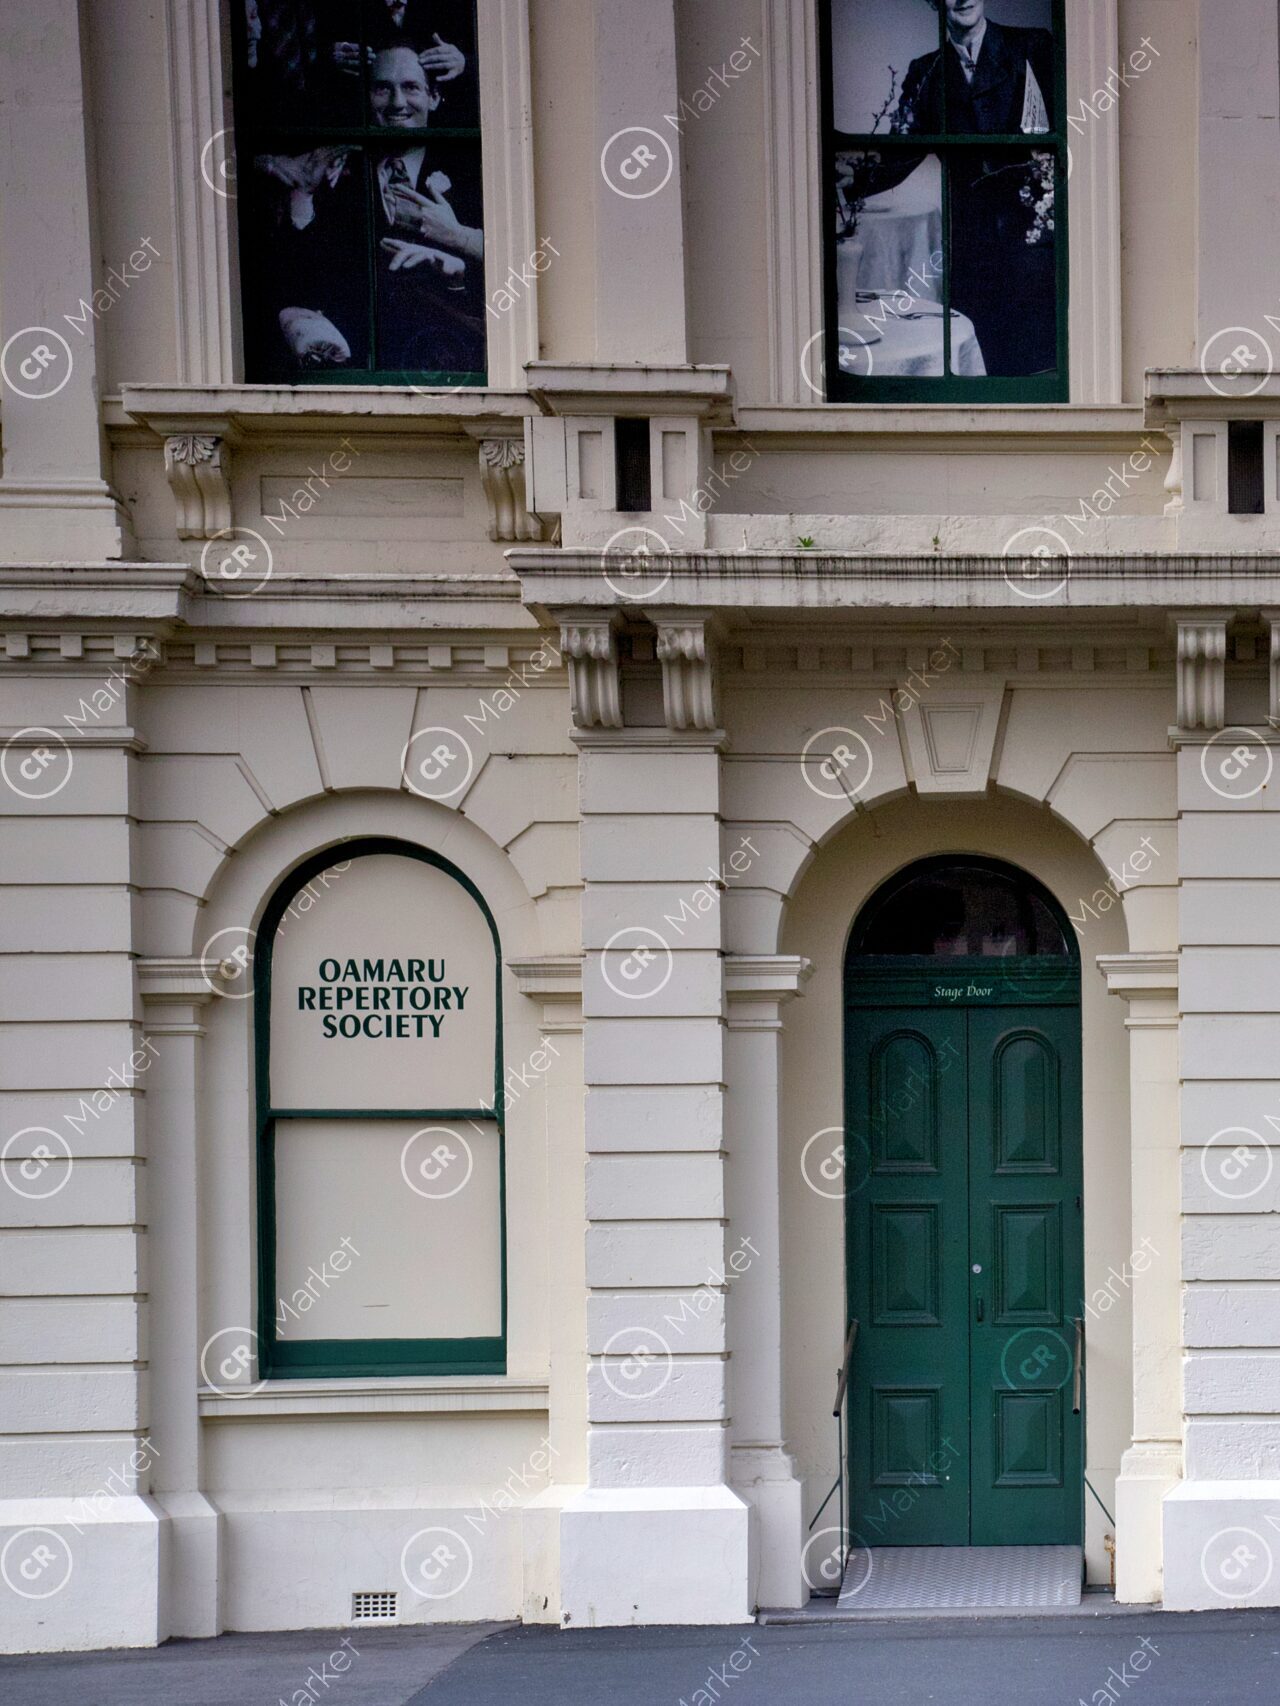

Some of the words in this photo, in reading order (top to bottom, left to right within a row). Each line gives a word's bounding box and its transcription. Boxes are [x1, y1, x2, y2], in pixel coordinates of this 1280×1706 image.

[319, 958, 445, 983] OAMARU
[298, 986, 469, 1010] REPERTORY
[934, 985, 963, 1002] Stage
[967, 984, 993, 997] Door
[322, 1014, 445, 1038] SOCIETY
